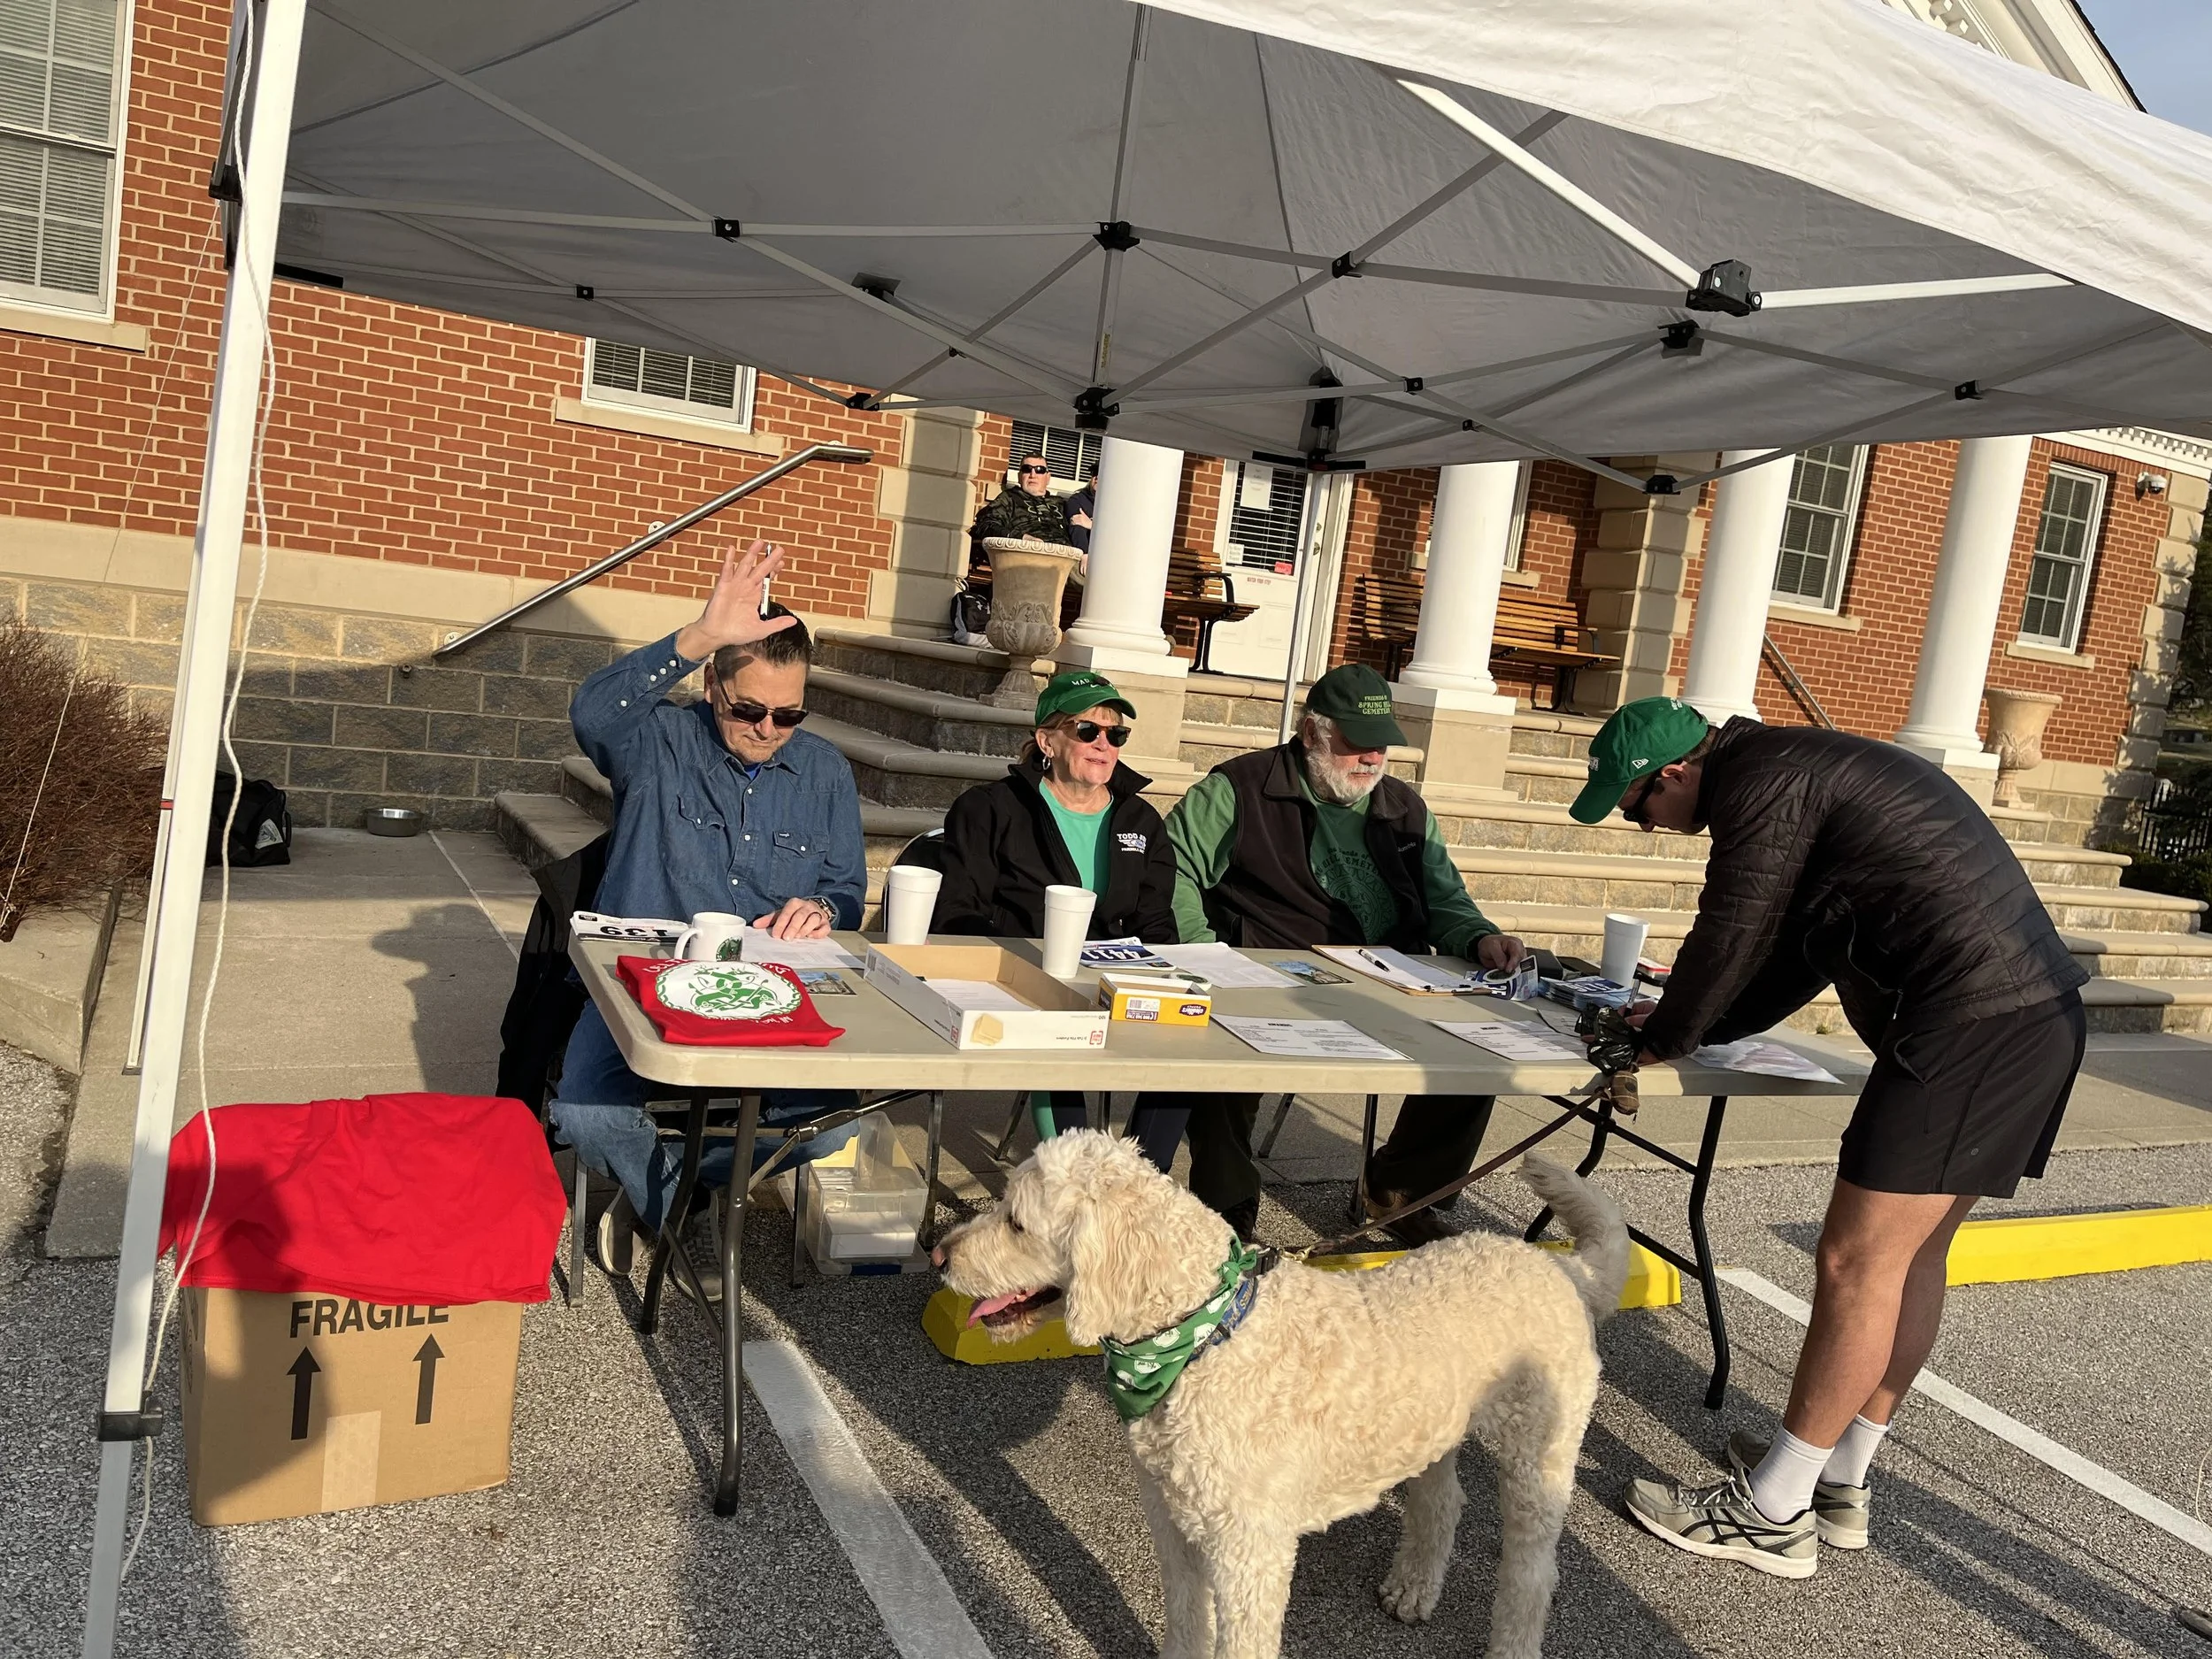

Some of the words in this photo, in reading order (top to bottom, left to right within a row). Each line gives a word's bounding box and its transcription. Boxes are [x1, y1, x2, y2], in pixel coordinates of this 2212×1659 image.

[600, 926, 669, 938] 139
[1082, 949, 1141, 960] 4411
[289, 1298, 449, 1339] FRAGILE
